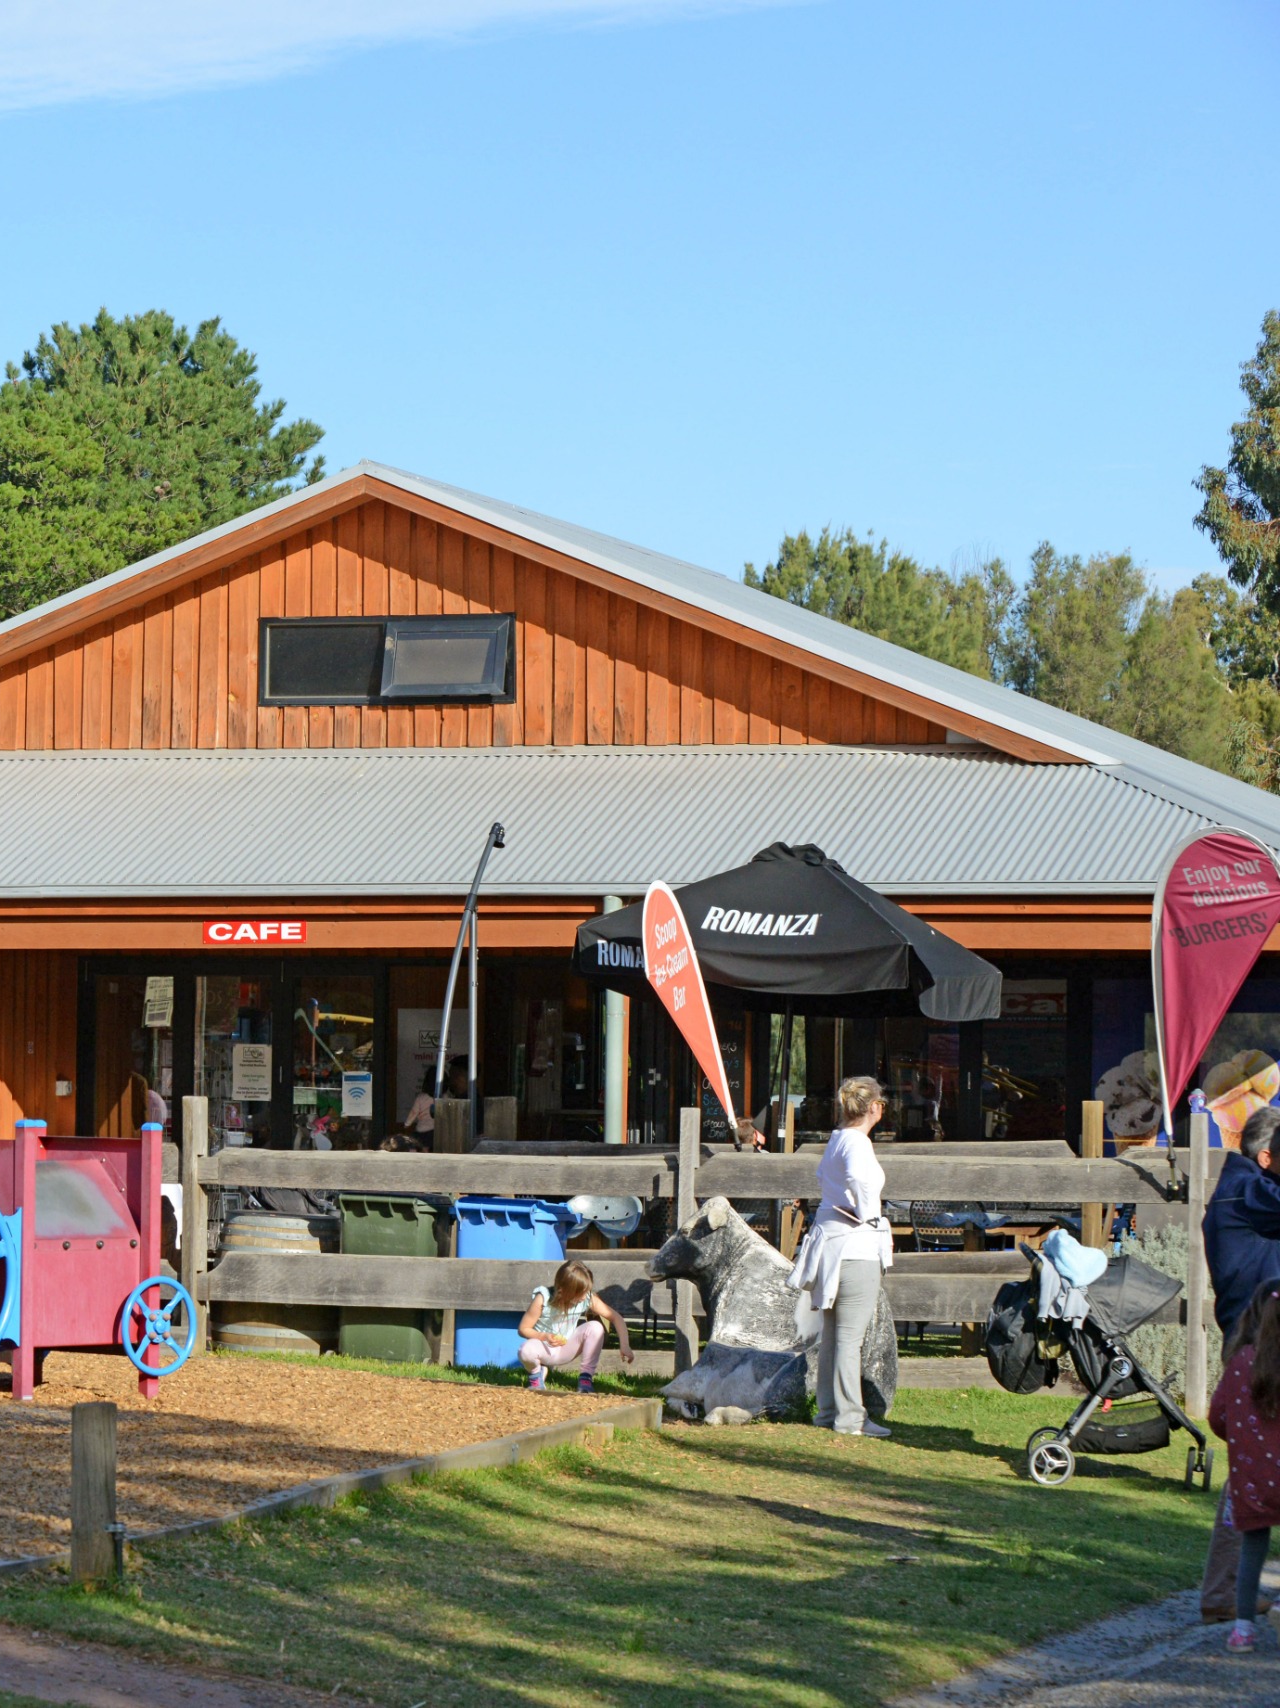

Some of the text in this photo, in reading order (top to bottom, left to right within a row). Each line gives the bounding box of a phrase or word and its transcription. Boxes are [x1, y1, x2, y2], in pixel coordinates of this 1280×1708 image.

[1183, 859, 1262, 886] Enjoy our
[1192, 881, 1269, 907] delicious
[208, 923, 302, 940] CAFE
[654, 916, 677, 949] Scoop
[701, 905, 819, 936] ROMANZA
[597, 940, 645, 968] ROMA
[666, 947, 689, 978] Cream
[673, 986, 686, 1011] Bar
